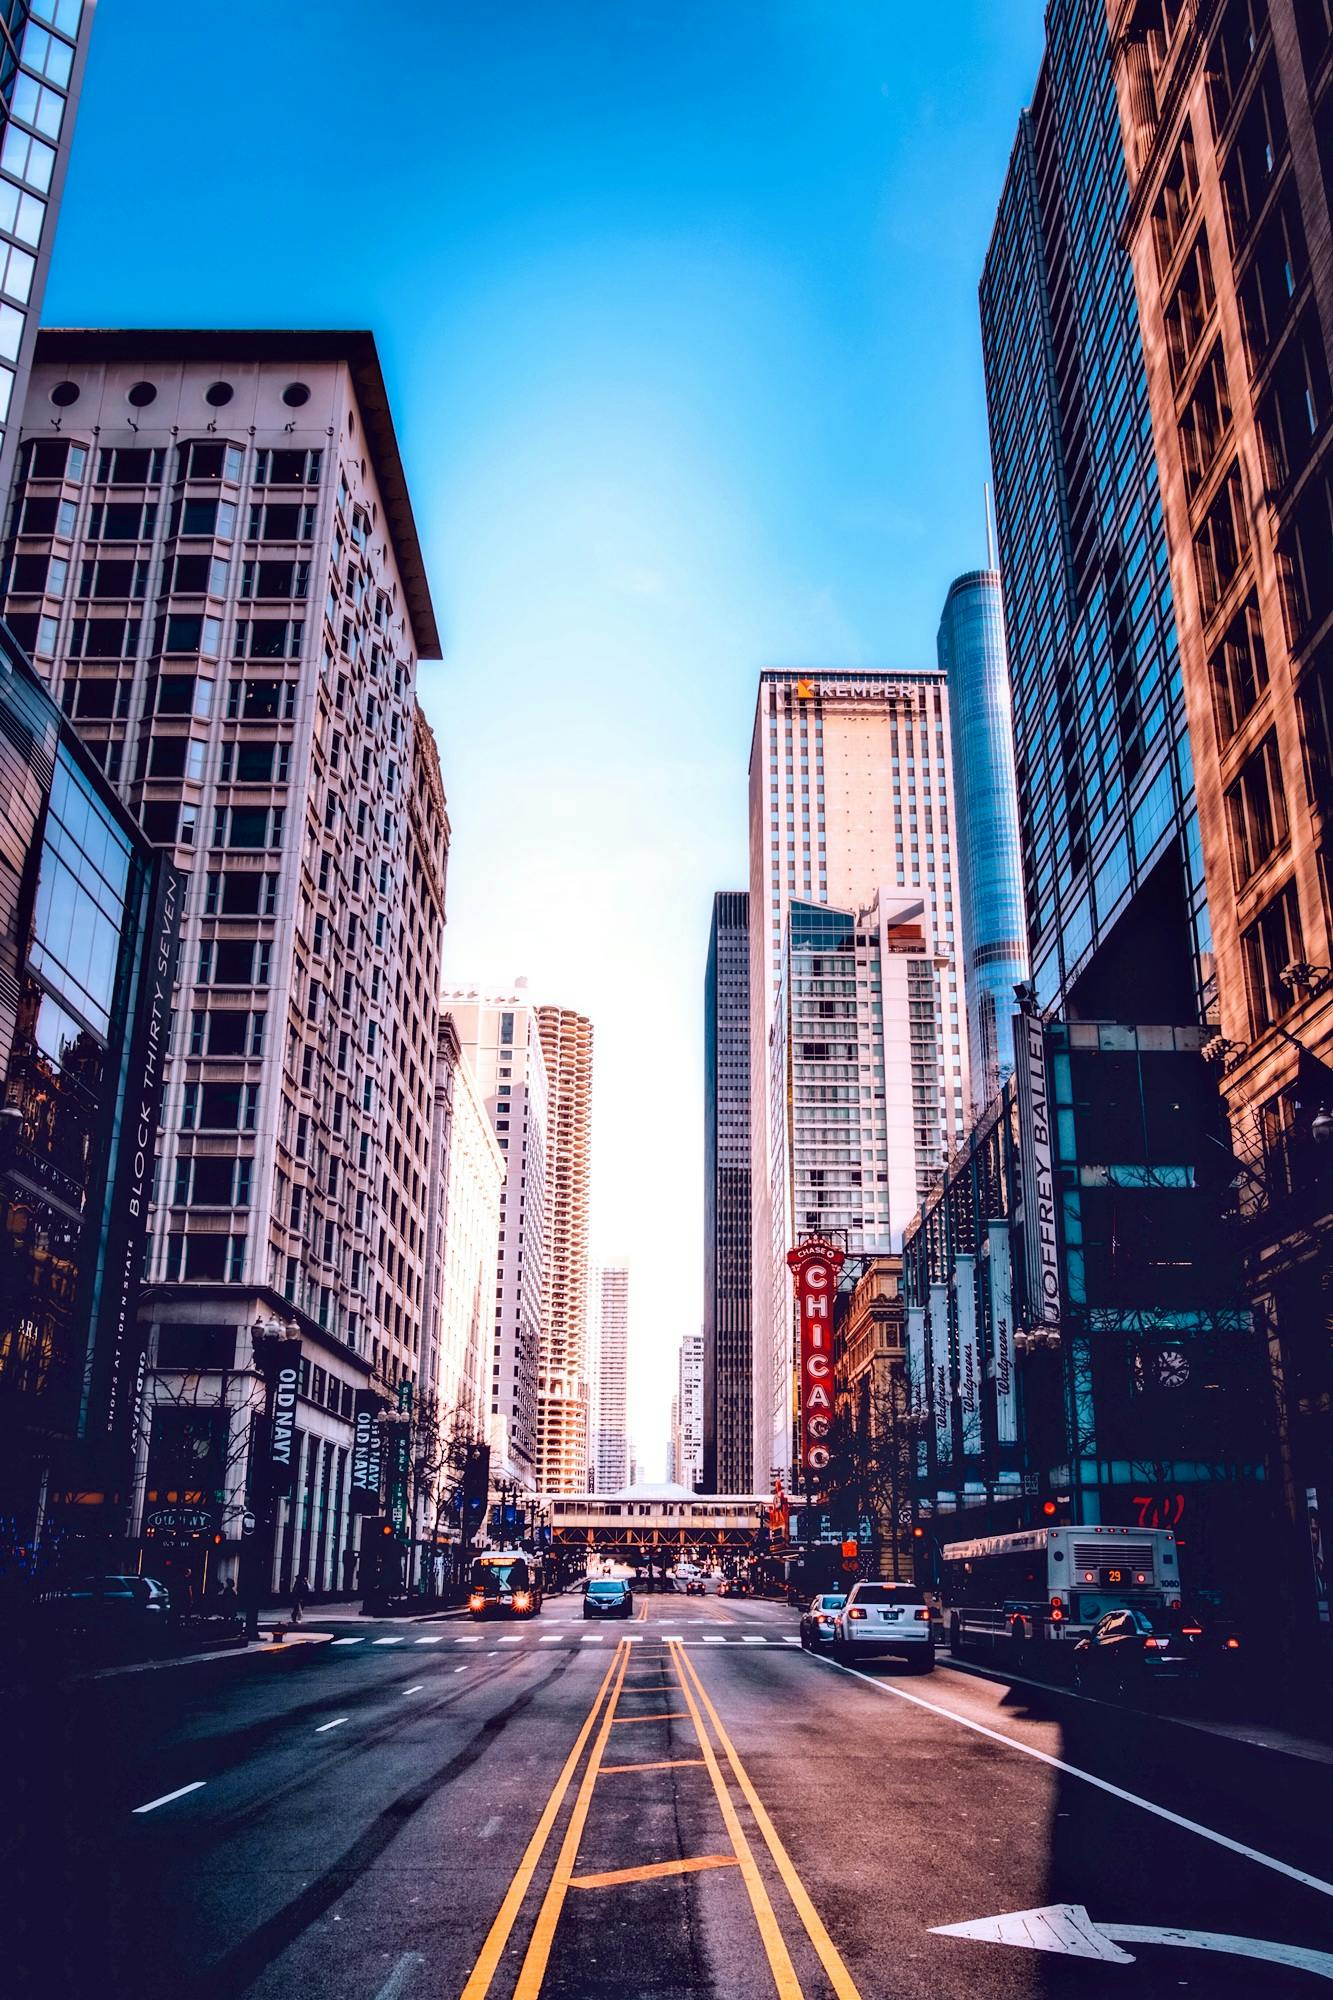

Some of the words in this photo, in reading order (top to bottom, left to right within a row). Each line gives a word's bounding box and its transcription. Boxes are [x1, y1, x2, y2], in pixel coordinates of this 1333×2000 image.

[819, 682, 913, 698] KEMPER
[129, 1101, 151, 1218] BLOCK
[143, 982, 165, 1089] THIRTY
[158, 875, 177, 977] SEVEN
[1027, 1017, 1049, 1147] BALLET
[797, 1246, 826, 1258] CHASE
[1035, 1157, 1061, 1320] JOFFREY
[123, 1239, 134, 1289] STATE
[121, 1296, 127, 1306] N
[117, 1312, 125, 1341] 108
[114, 1349, 121, 1369] AT
[136, 1351, 147, 1393] OLD
[805, 1265, 831, 1469] CHICAGO
[963, 1342, 978, 1415] Walgreens
[997, 1317, 1014, 1398] Walgreens
[277, 1368, 297, 1408] OLD
[936, 1364, 950, 1430] Walgreens
[272, 1411, 295, 1465] NAVY
[356, 1412, 372, 1444] OLD
[353, 1446, 369, 1490] NAVY
[1108, 1570, 1121, 1582] 29
